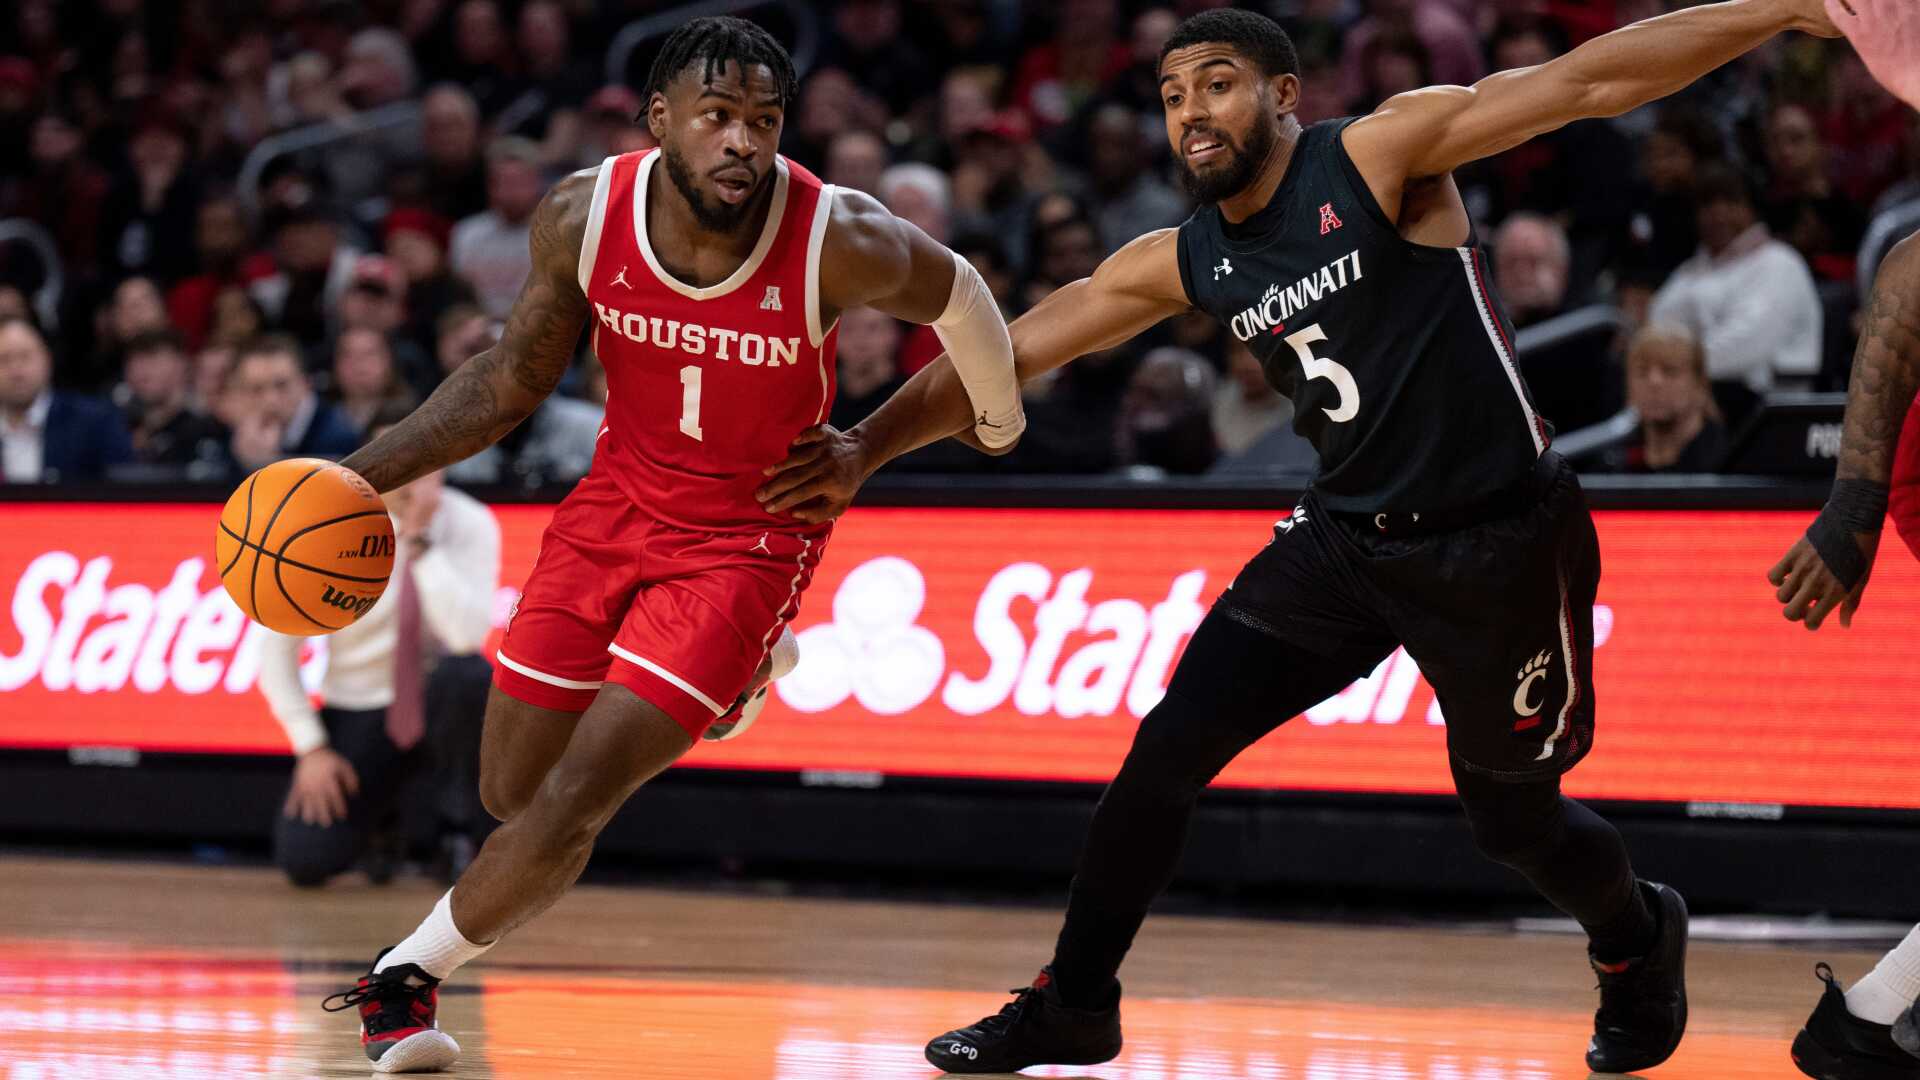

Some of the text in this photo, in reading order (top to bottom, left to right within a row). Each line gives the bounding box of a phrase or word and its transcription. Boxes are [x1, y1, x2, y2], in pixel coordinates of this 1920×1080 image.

[595, 302, 800, 367] HOUSTON
[1231, 250, 1363, 342] CINCINNATI
[680, 365, 702, 441] 1
[1284, 323, 1360, 423] 5
